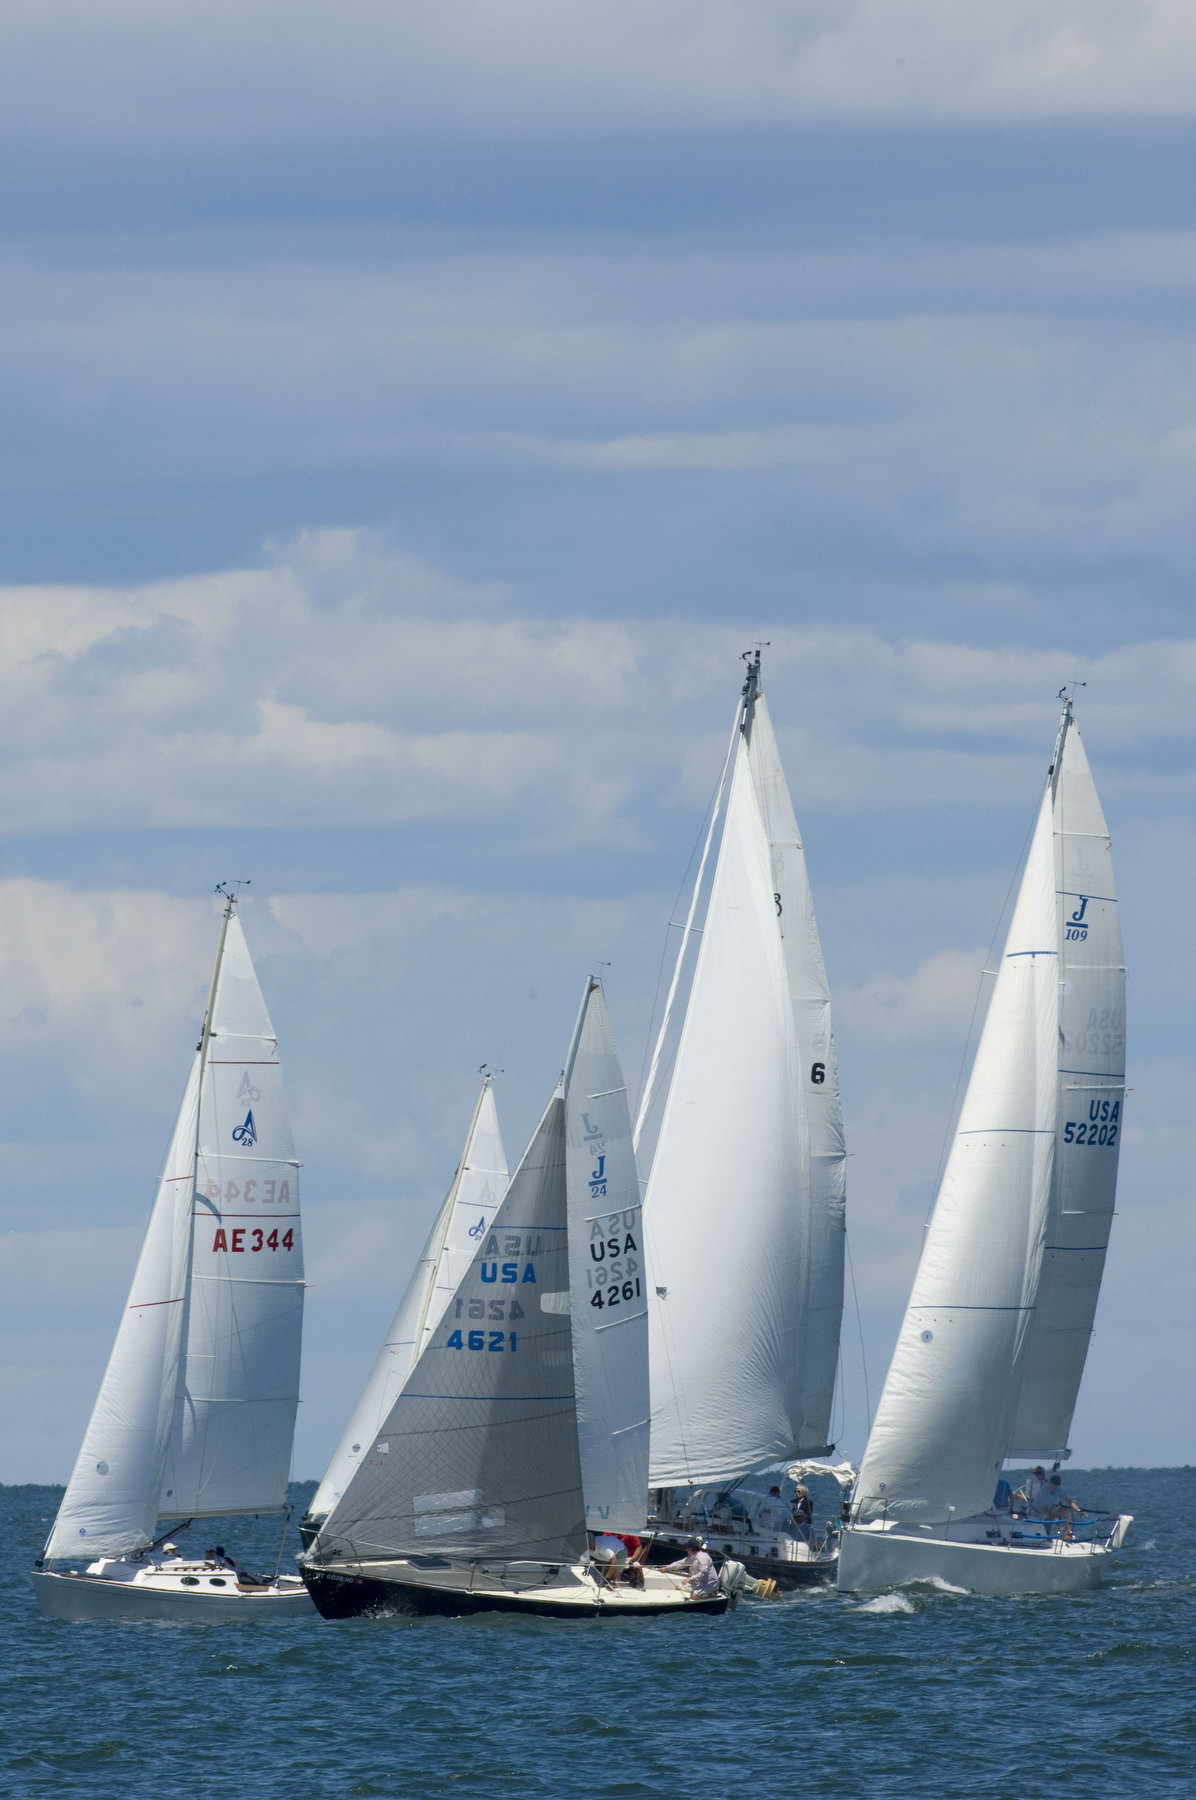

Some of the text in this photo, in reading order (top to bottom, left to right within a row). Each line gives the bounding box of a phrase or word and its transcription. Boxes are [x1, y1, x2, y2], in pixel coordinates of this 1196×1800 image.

[1071, 895, 1088, 921] J
[1064, 928, 1088, 942] 109
[811, 1062, 825, 1085] 6
[1089, 1100, 1120, 1123] USA
[241, 1137, 254, 1147] 28
[1064, 1121, 1118, 1146] 52202
[592, 1155, 606, 1179] J
[591, 1184, 607, 1199] 24
[212, 1228, 294, 1252] AE344
[590, 1233, 637, 1262] USA
[481, 1262, 536, 1283] USA
[590, 1277, 640, 1310] 4261
[447, 1329, 517, 1352] 4621
